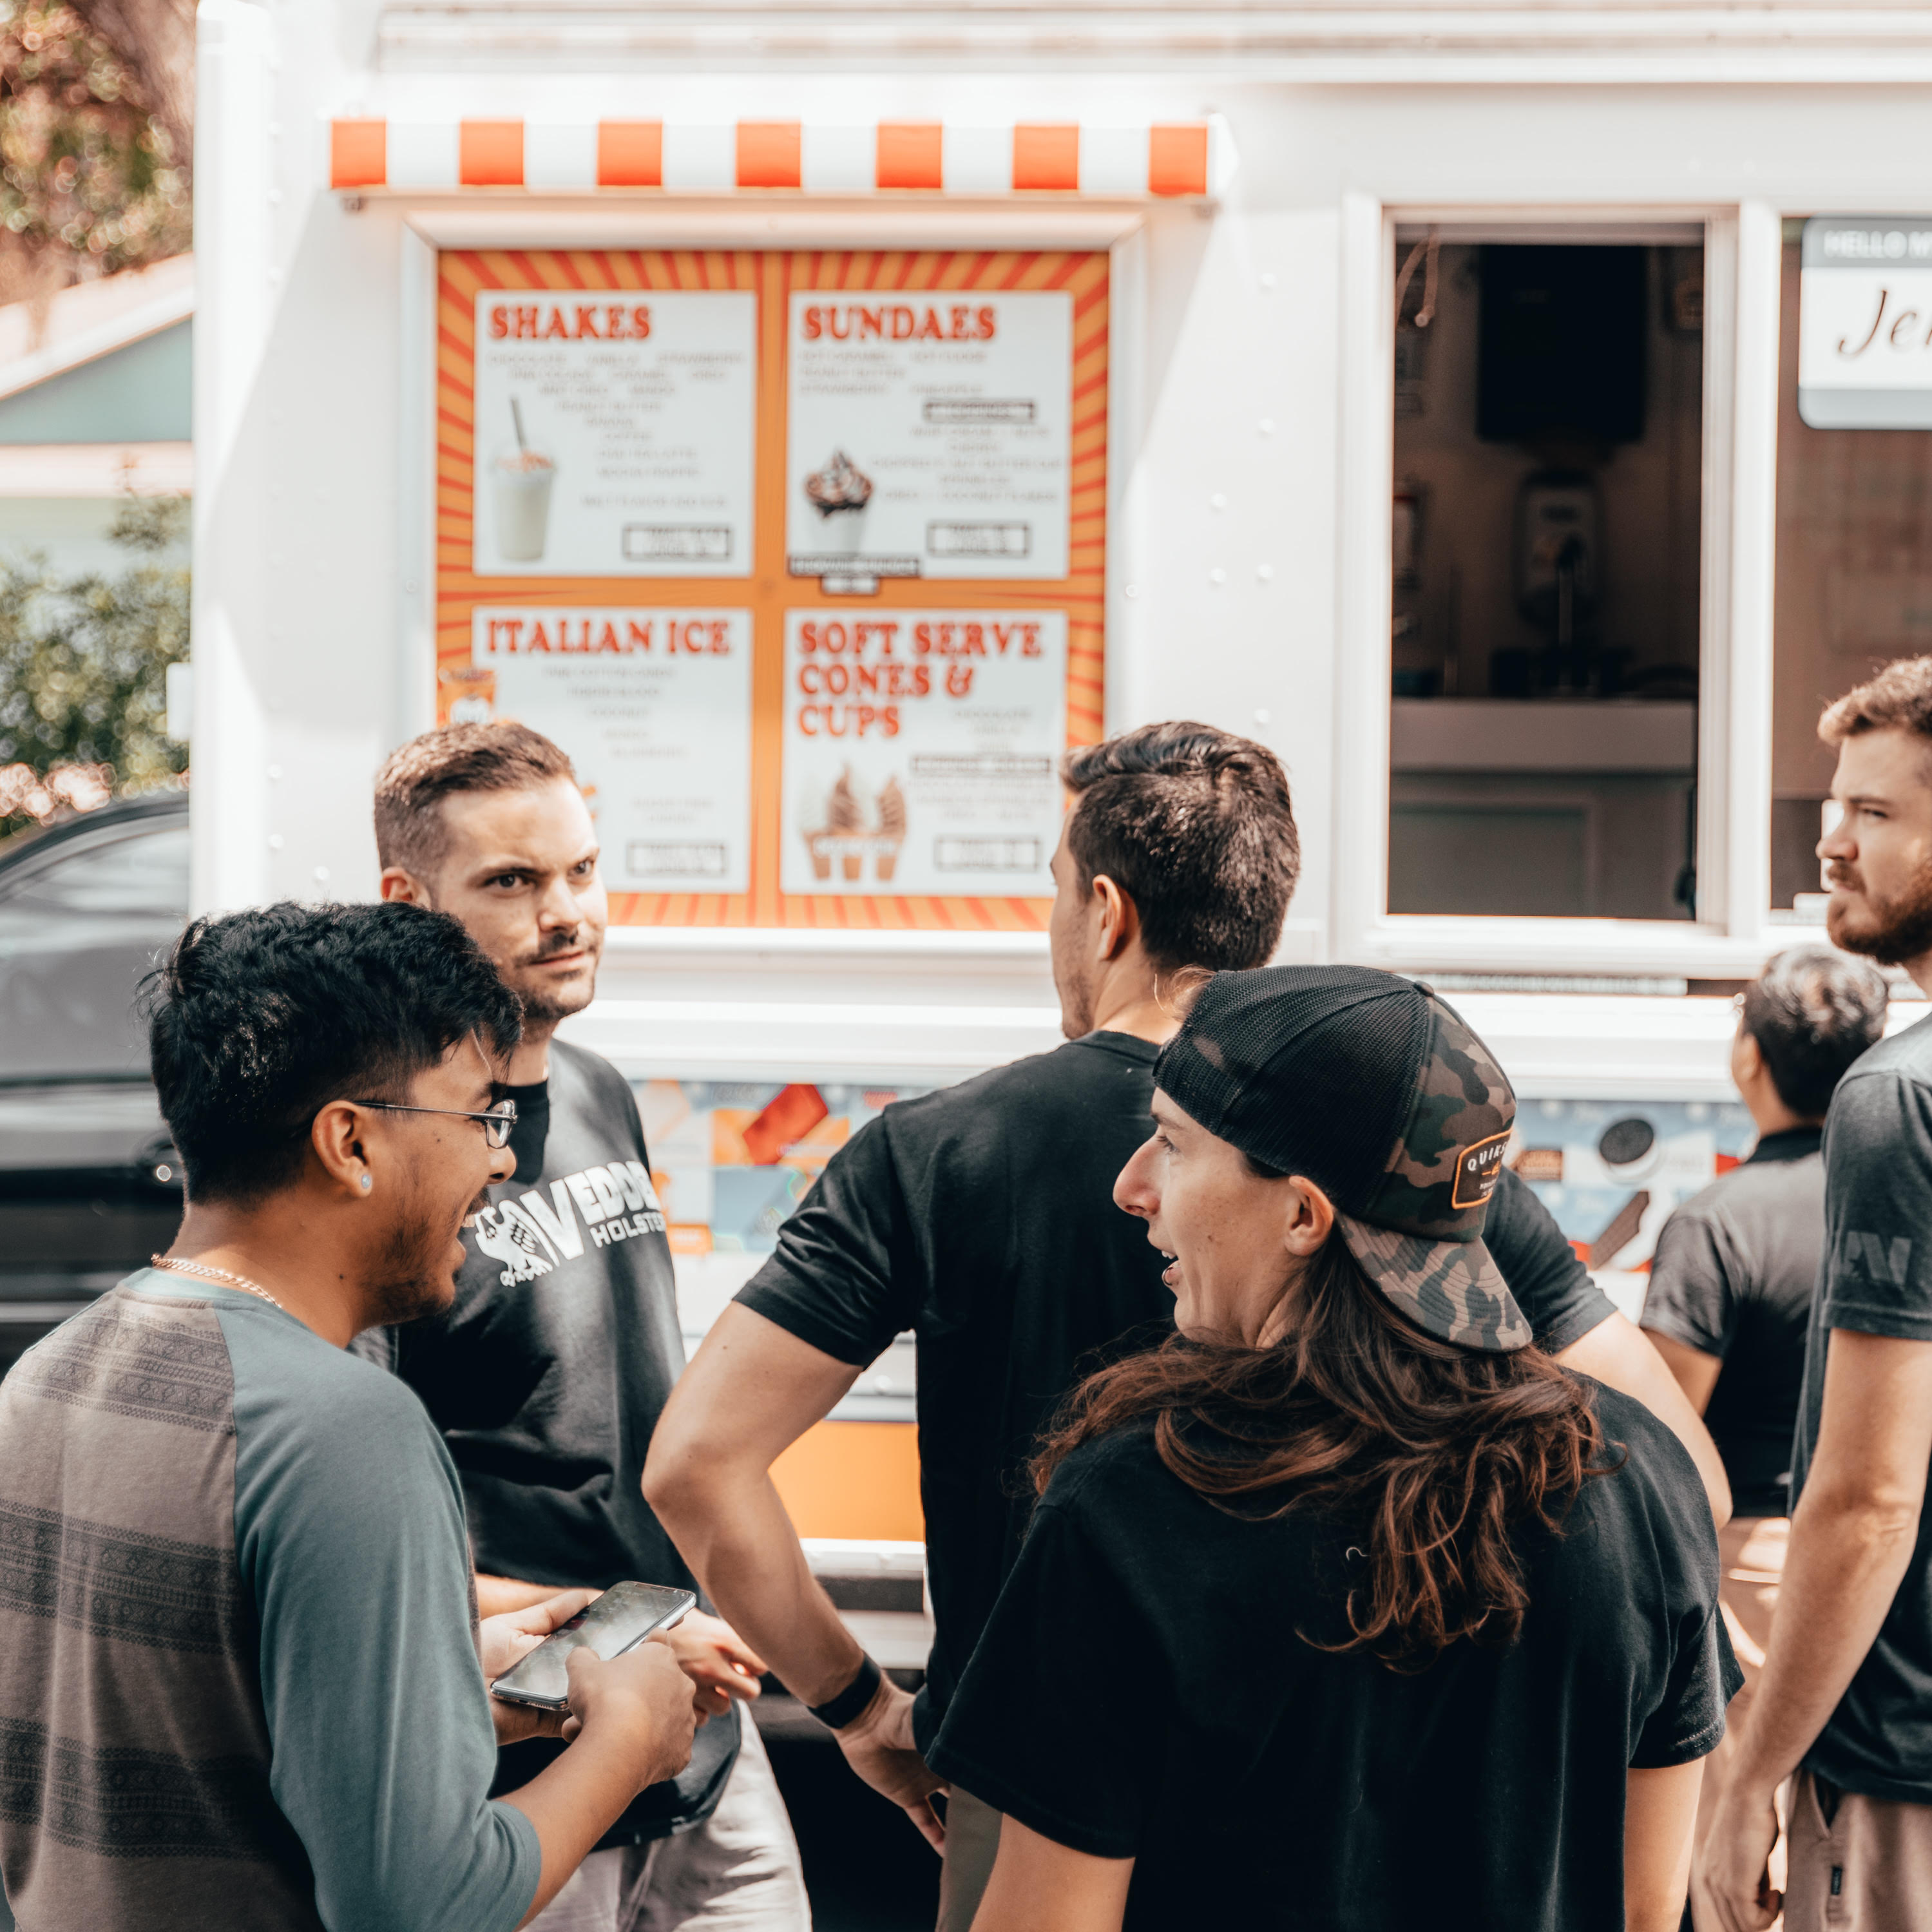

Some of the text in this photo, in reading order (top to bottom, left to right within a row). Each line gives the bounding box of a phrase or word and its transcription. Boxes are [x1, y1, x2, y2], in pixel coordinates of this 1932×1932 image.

[1824, 230, 1907, 258] HELLO
[490, 304, 651, 340] SHAKES
[803, 305, 997, 341] SUNDAES
[1837, 289, 1932, 359] Je
[488, 618, 732, 656] ITALIAN ICE
[799, 621, 1043, 657] SOFT SERVE
[798, 663, 975, 698] CONES &
[797, 705, 901, 738] CUPS
